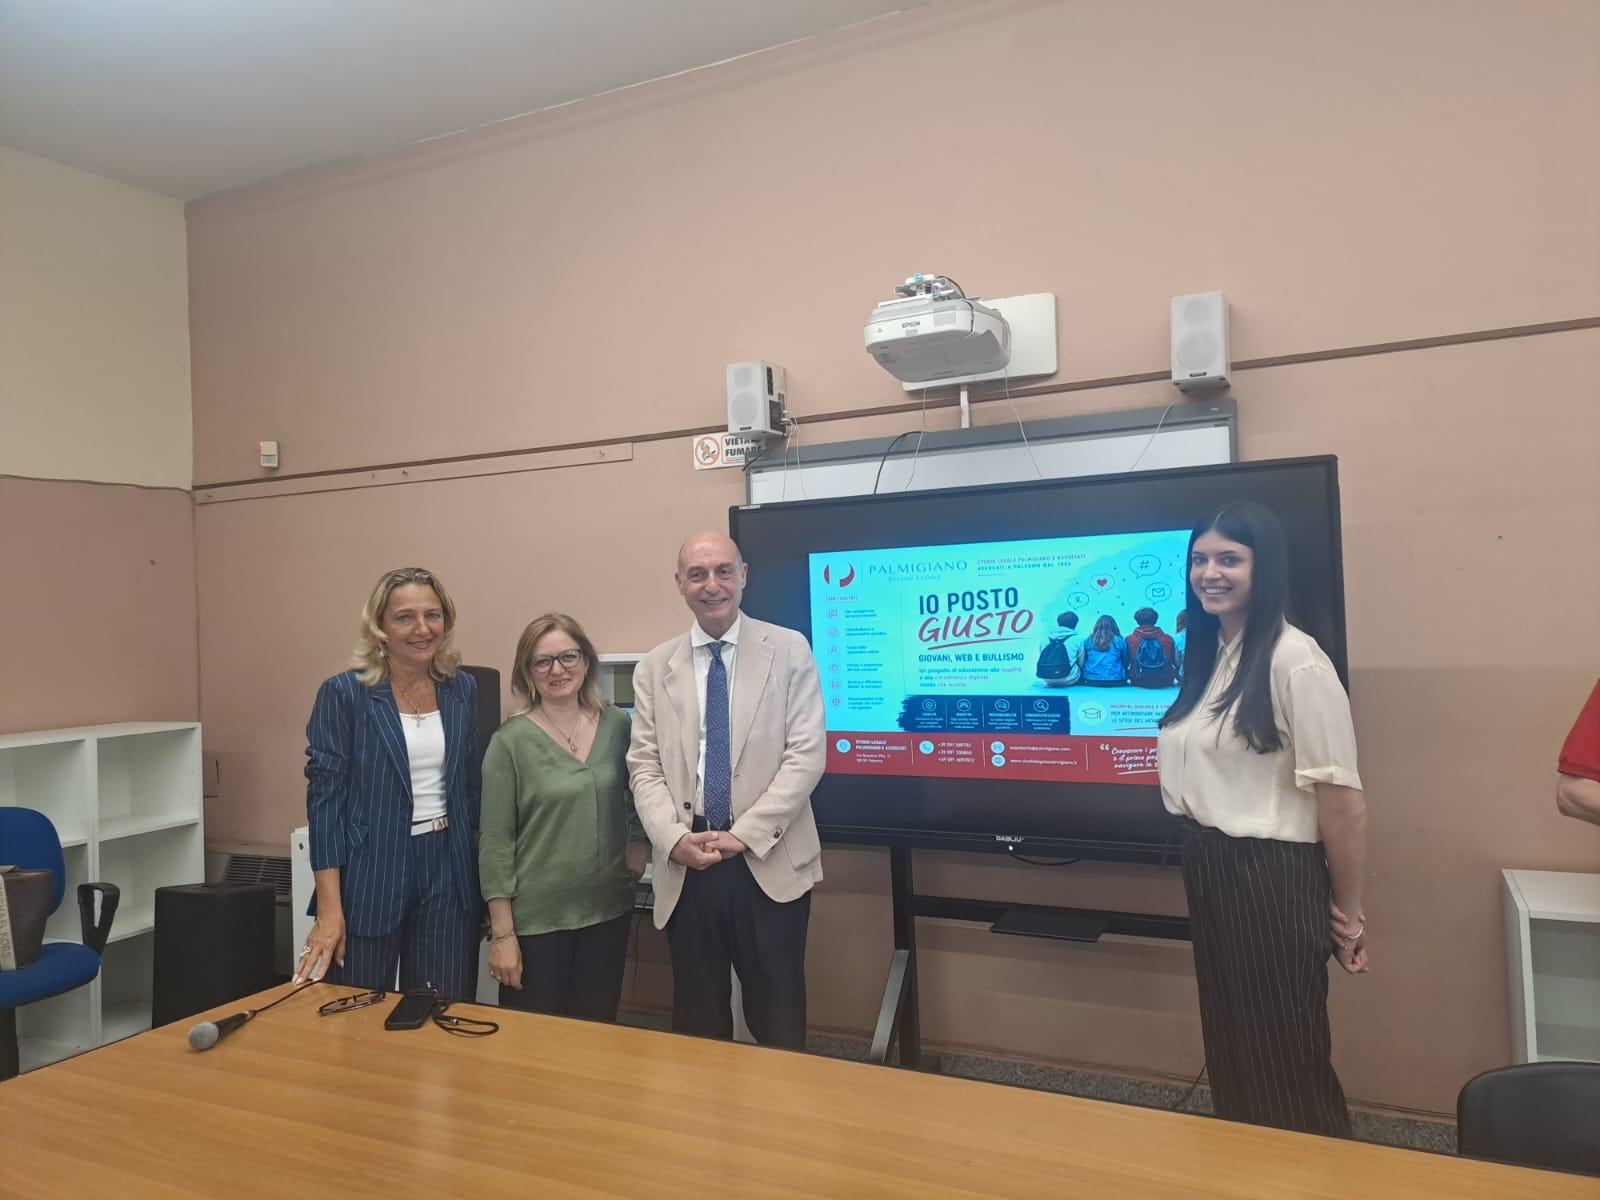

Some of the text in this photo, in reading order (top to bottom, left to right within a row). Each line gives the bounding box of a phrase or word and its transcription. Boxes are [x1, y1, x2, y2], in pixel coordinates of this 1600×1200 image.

[868, 560, 968, 575] PALMIGIANO
[919, 587, 1018, 615] IO POSTO
[918, 609, 1034, 643] GIUSTO
[918, 652, 1024, 663] GIOVANI, WEB E BULLISMO
[1125, 754, 1145, 763] primo
[1114, 762, 1144, 771] navigare
